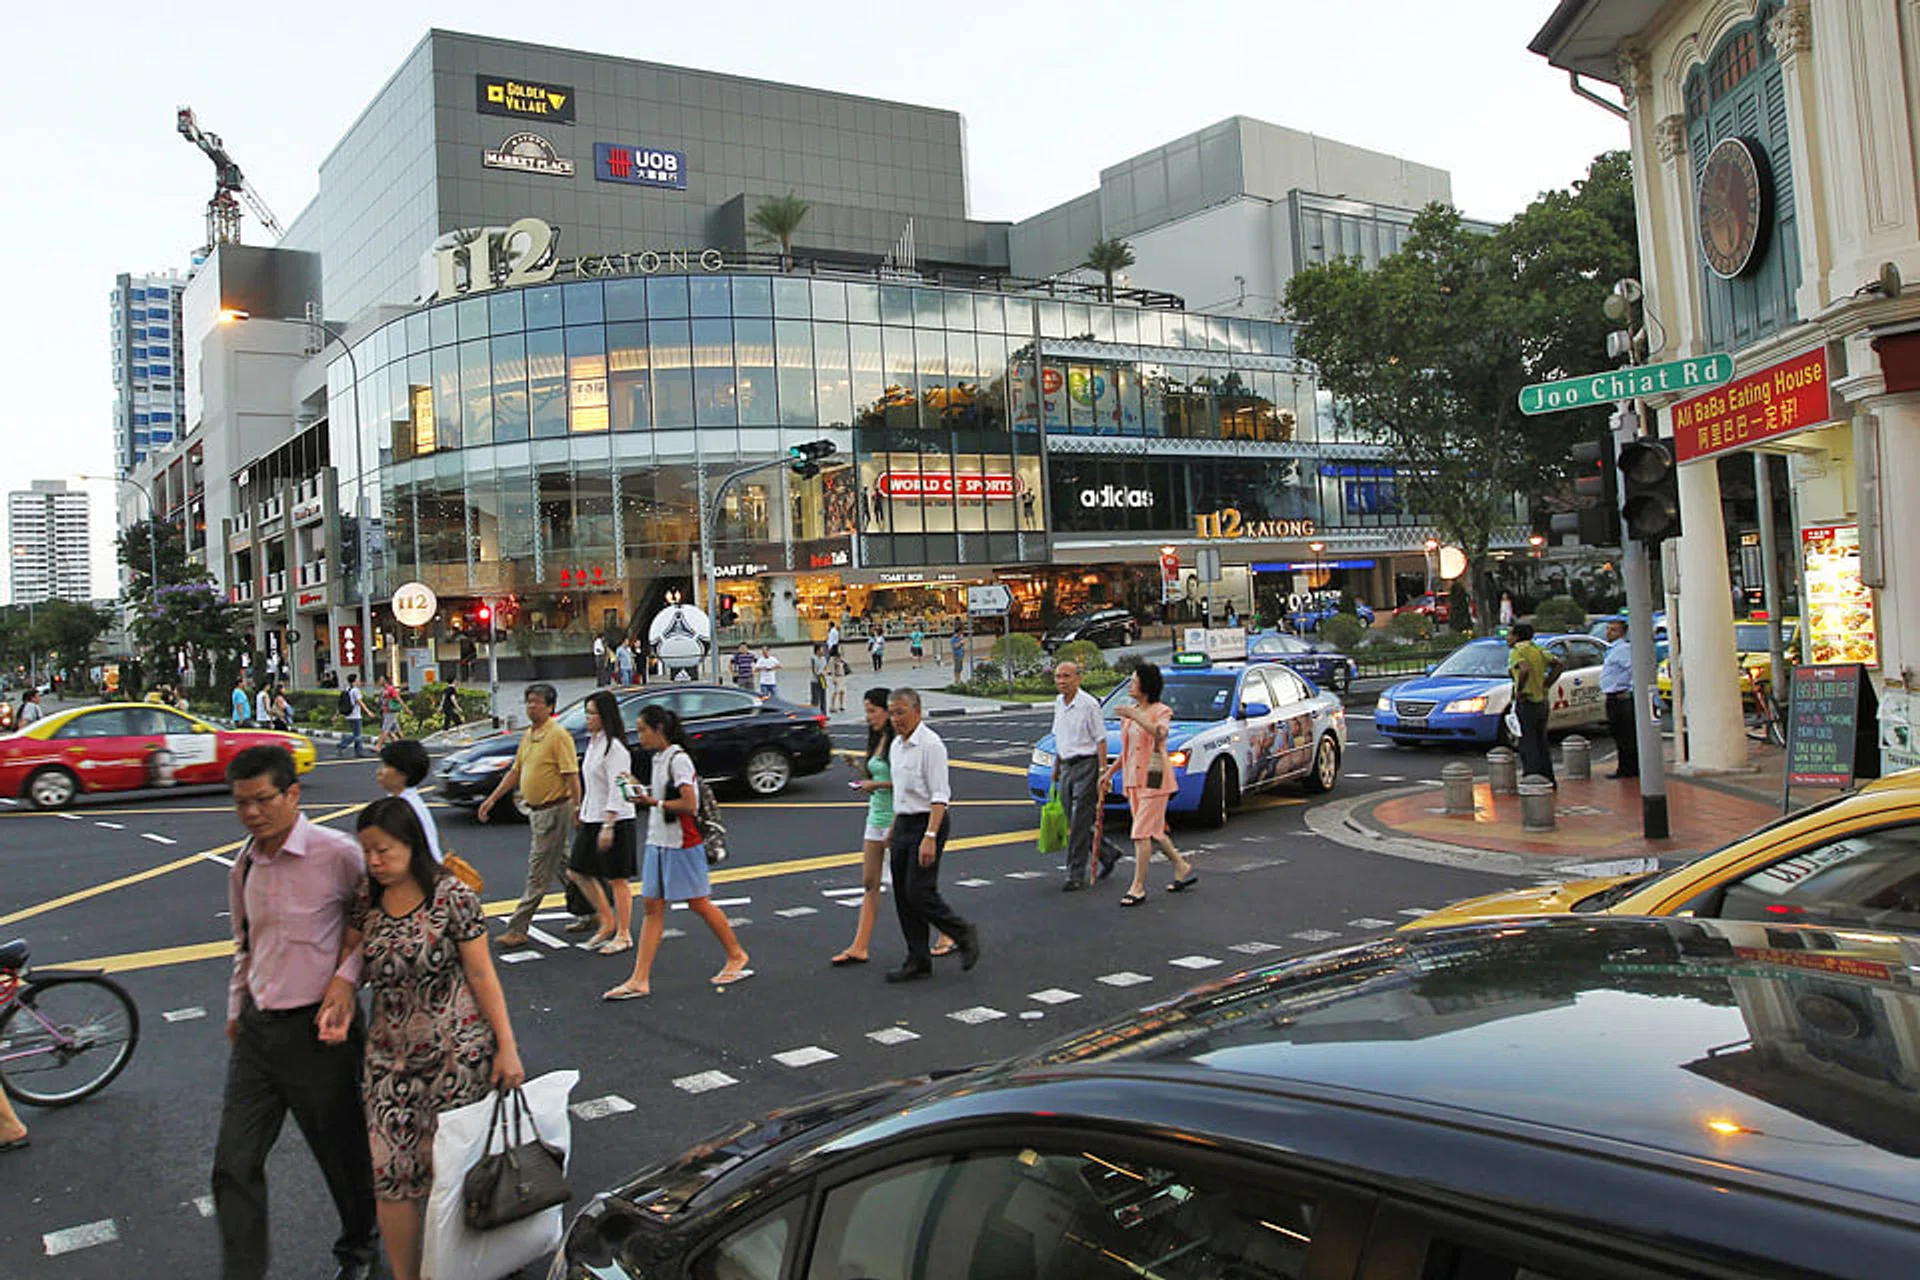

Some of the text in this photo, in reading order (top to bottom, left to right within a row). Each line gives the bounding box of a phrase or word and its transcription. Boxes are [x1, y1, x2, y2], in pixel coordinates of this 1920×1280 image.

[506, 81, 546, 100] GOLDEN
[506, 95, 548, 114] VILLAGE
[635, 150, 678, 171] UOB
[434, 218, 724, 302] 112 KATONG
[1533, 358, 1718, 410] Joo Chiat Rd
[1694, 396, 1726, 423] BaBa
[1729, 381, 1771, 411] Eating
[1774, 362, 1822, 395] House
[890, 478, 939, 492] WORLD
[966, 479, 1014, 493] SPORTS
[1080, 485, 1153, 508] adidas
[1195, 508, 1315, 539] 112 KATONG
[712, 565, 744, 578] OAST
[399, 593, 428, 609] 112
